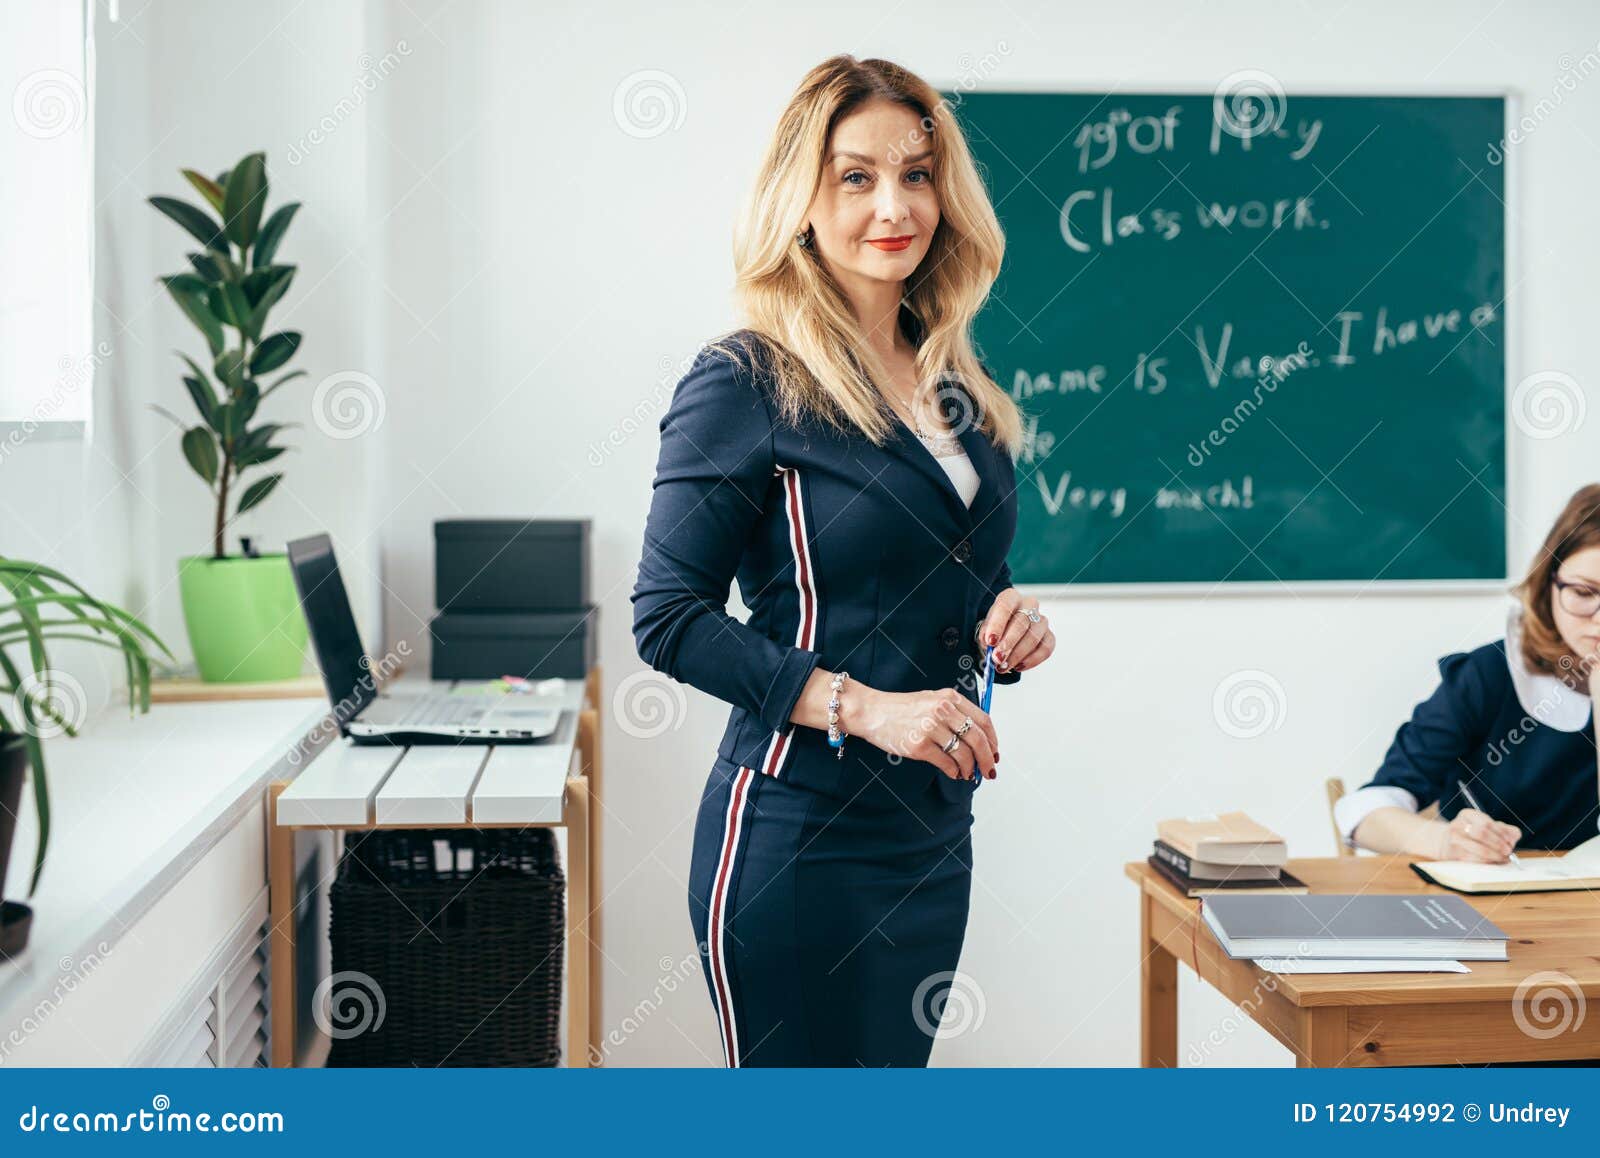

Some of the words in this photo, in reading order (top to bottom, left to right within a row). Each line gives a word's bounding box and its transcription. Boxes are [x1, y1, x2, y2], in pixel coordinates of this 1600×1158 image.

[1059, 187, 1182, 252] Class
[1329, 311, 1363, 367] I
[1373, 307, 1461, 355] have
[1036, 469, 1126, 518] Very
